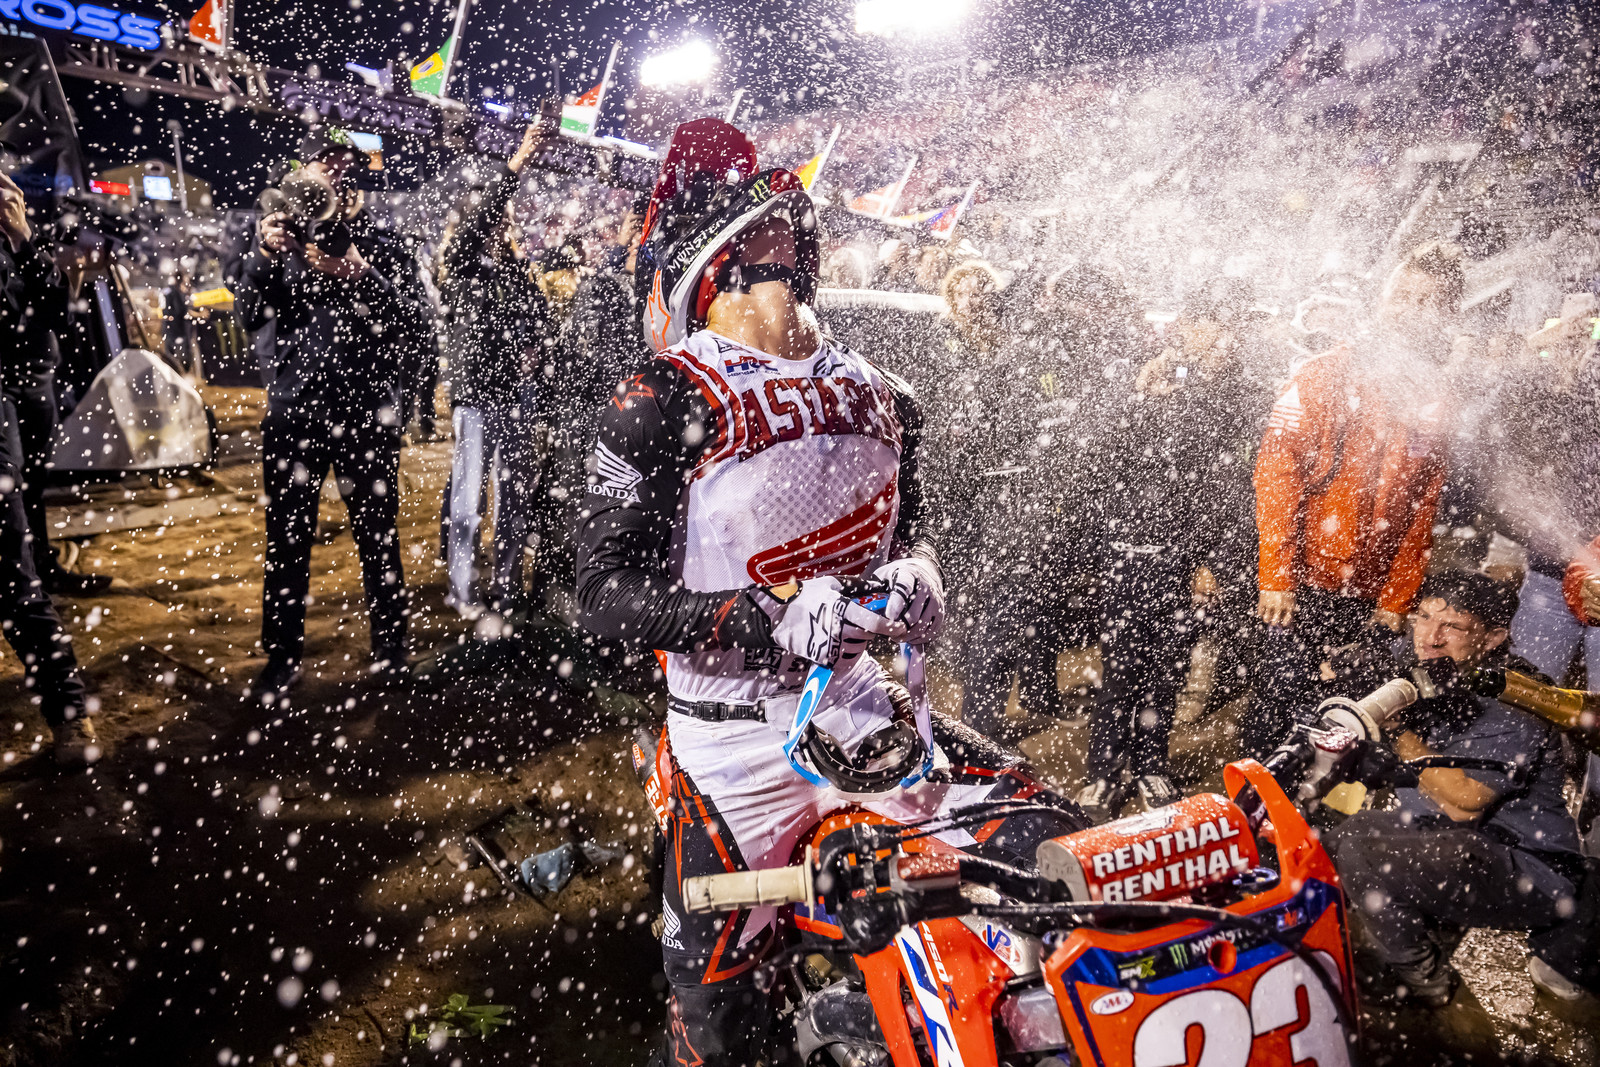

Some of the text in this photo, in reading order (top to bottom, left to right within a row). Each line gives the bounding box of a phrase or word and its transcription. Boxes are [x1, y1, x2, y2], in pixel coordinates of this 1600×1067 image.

[1093, 817, 1239, 877] RENTHAL
[1102, 844, 1249, 901] RENTHAL
[662, 933, 685, 950] NDA
[1134, 951, 1344, 1067] 23
